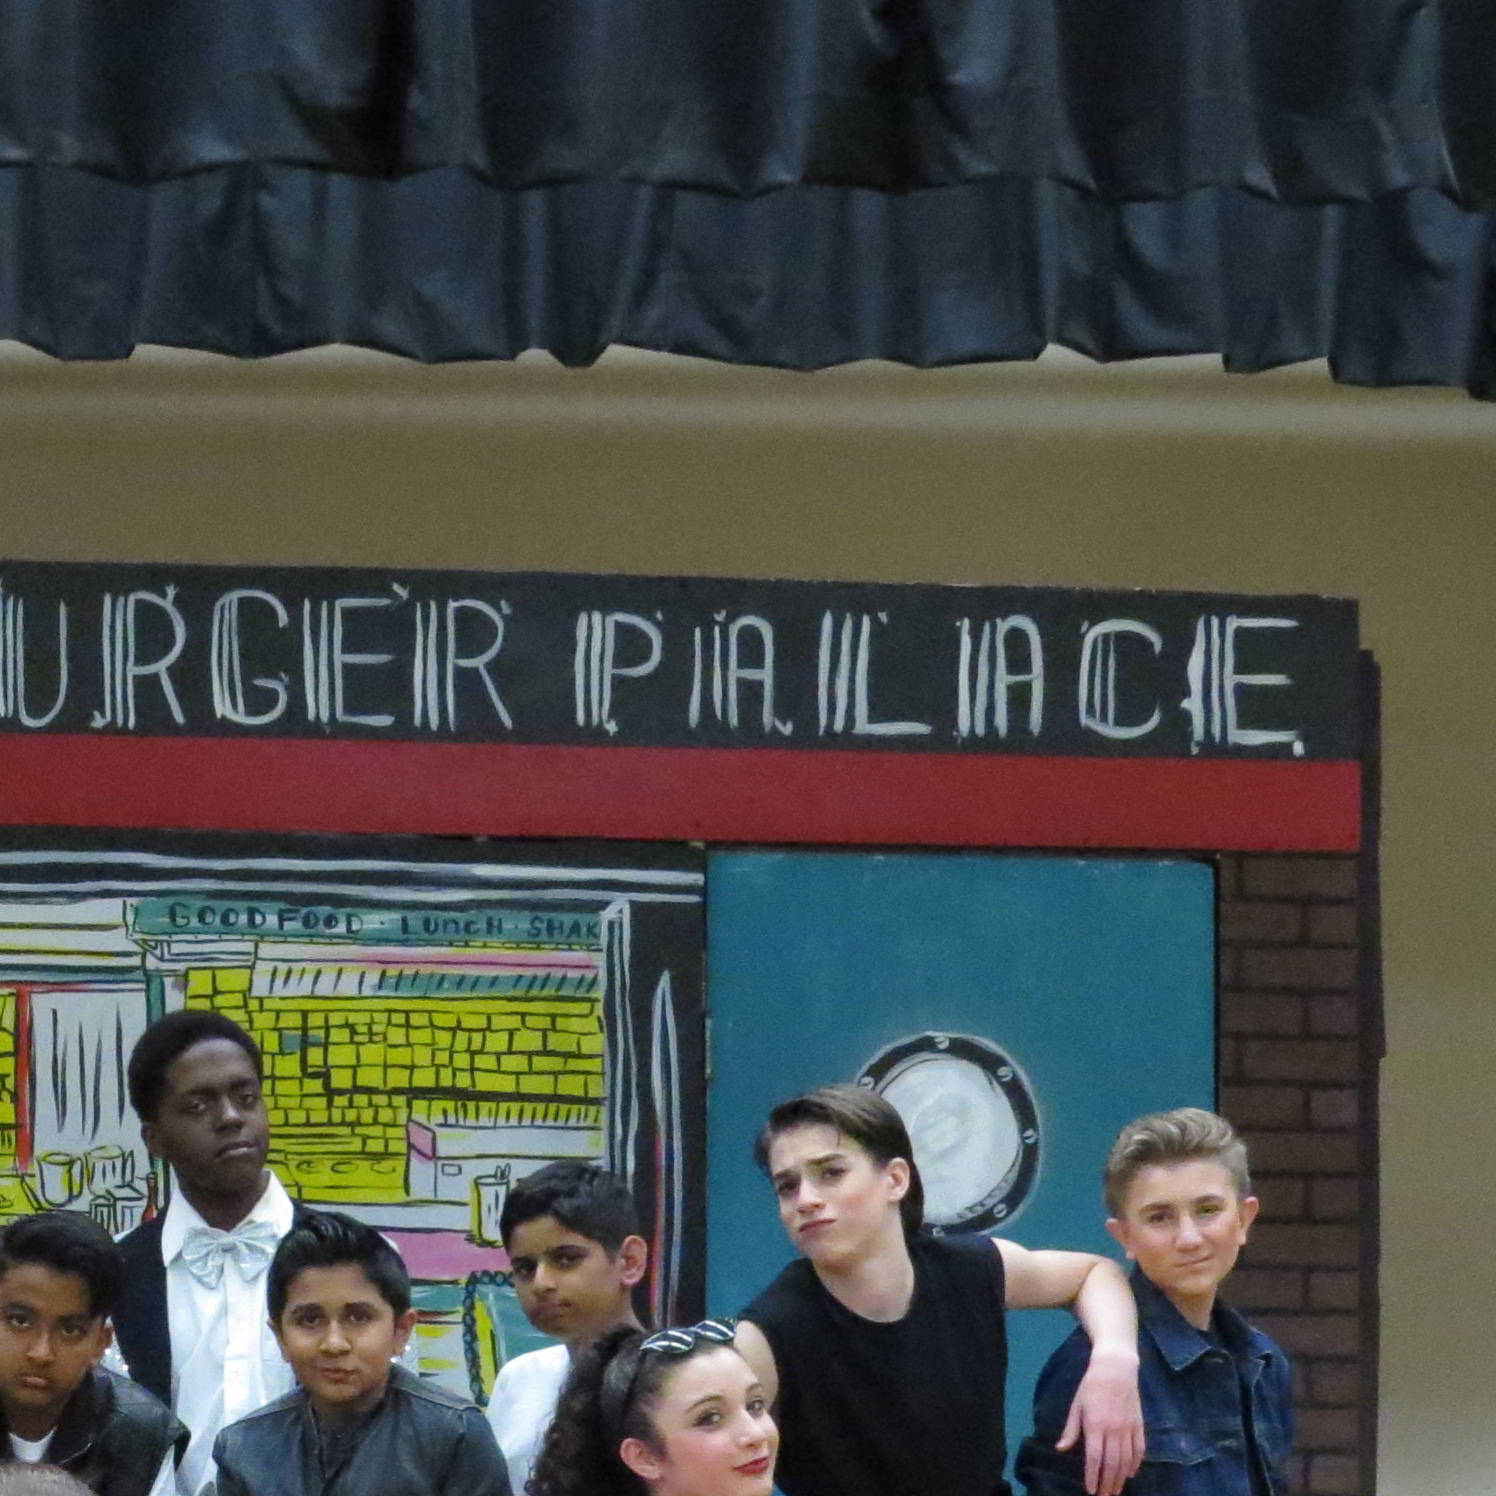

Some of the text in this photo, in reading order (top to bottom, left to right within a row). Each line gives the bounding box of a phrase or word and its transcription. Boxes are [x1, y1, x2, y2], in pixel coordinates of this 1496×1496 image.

[575, 610, 1303, 754] PALACE
[169, 902, 267, 929] GOOD
[277, 907, 364, 935] FOOD
